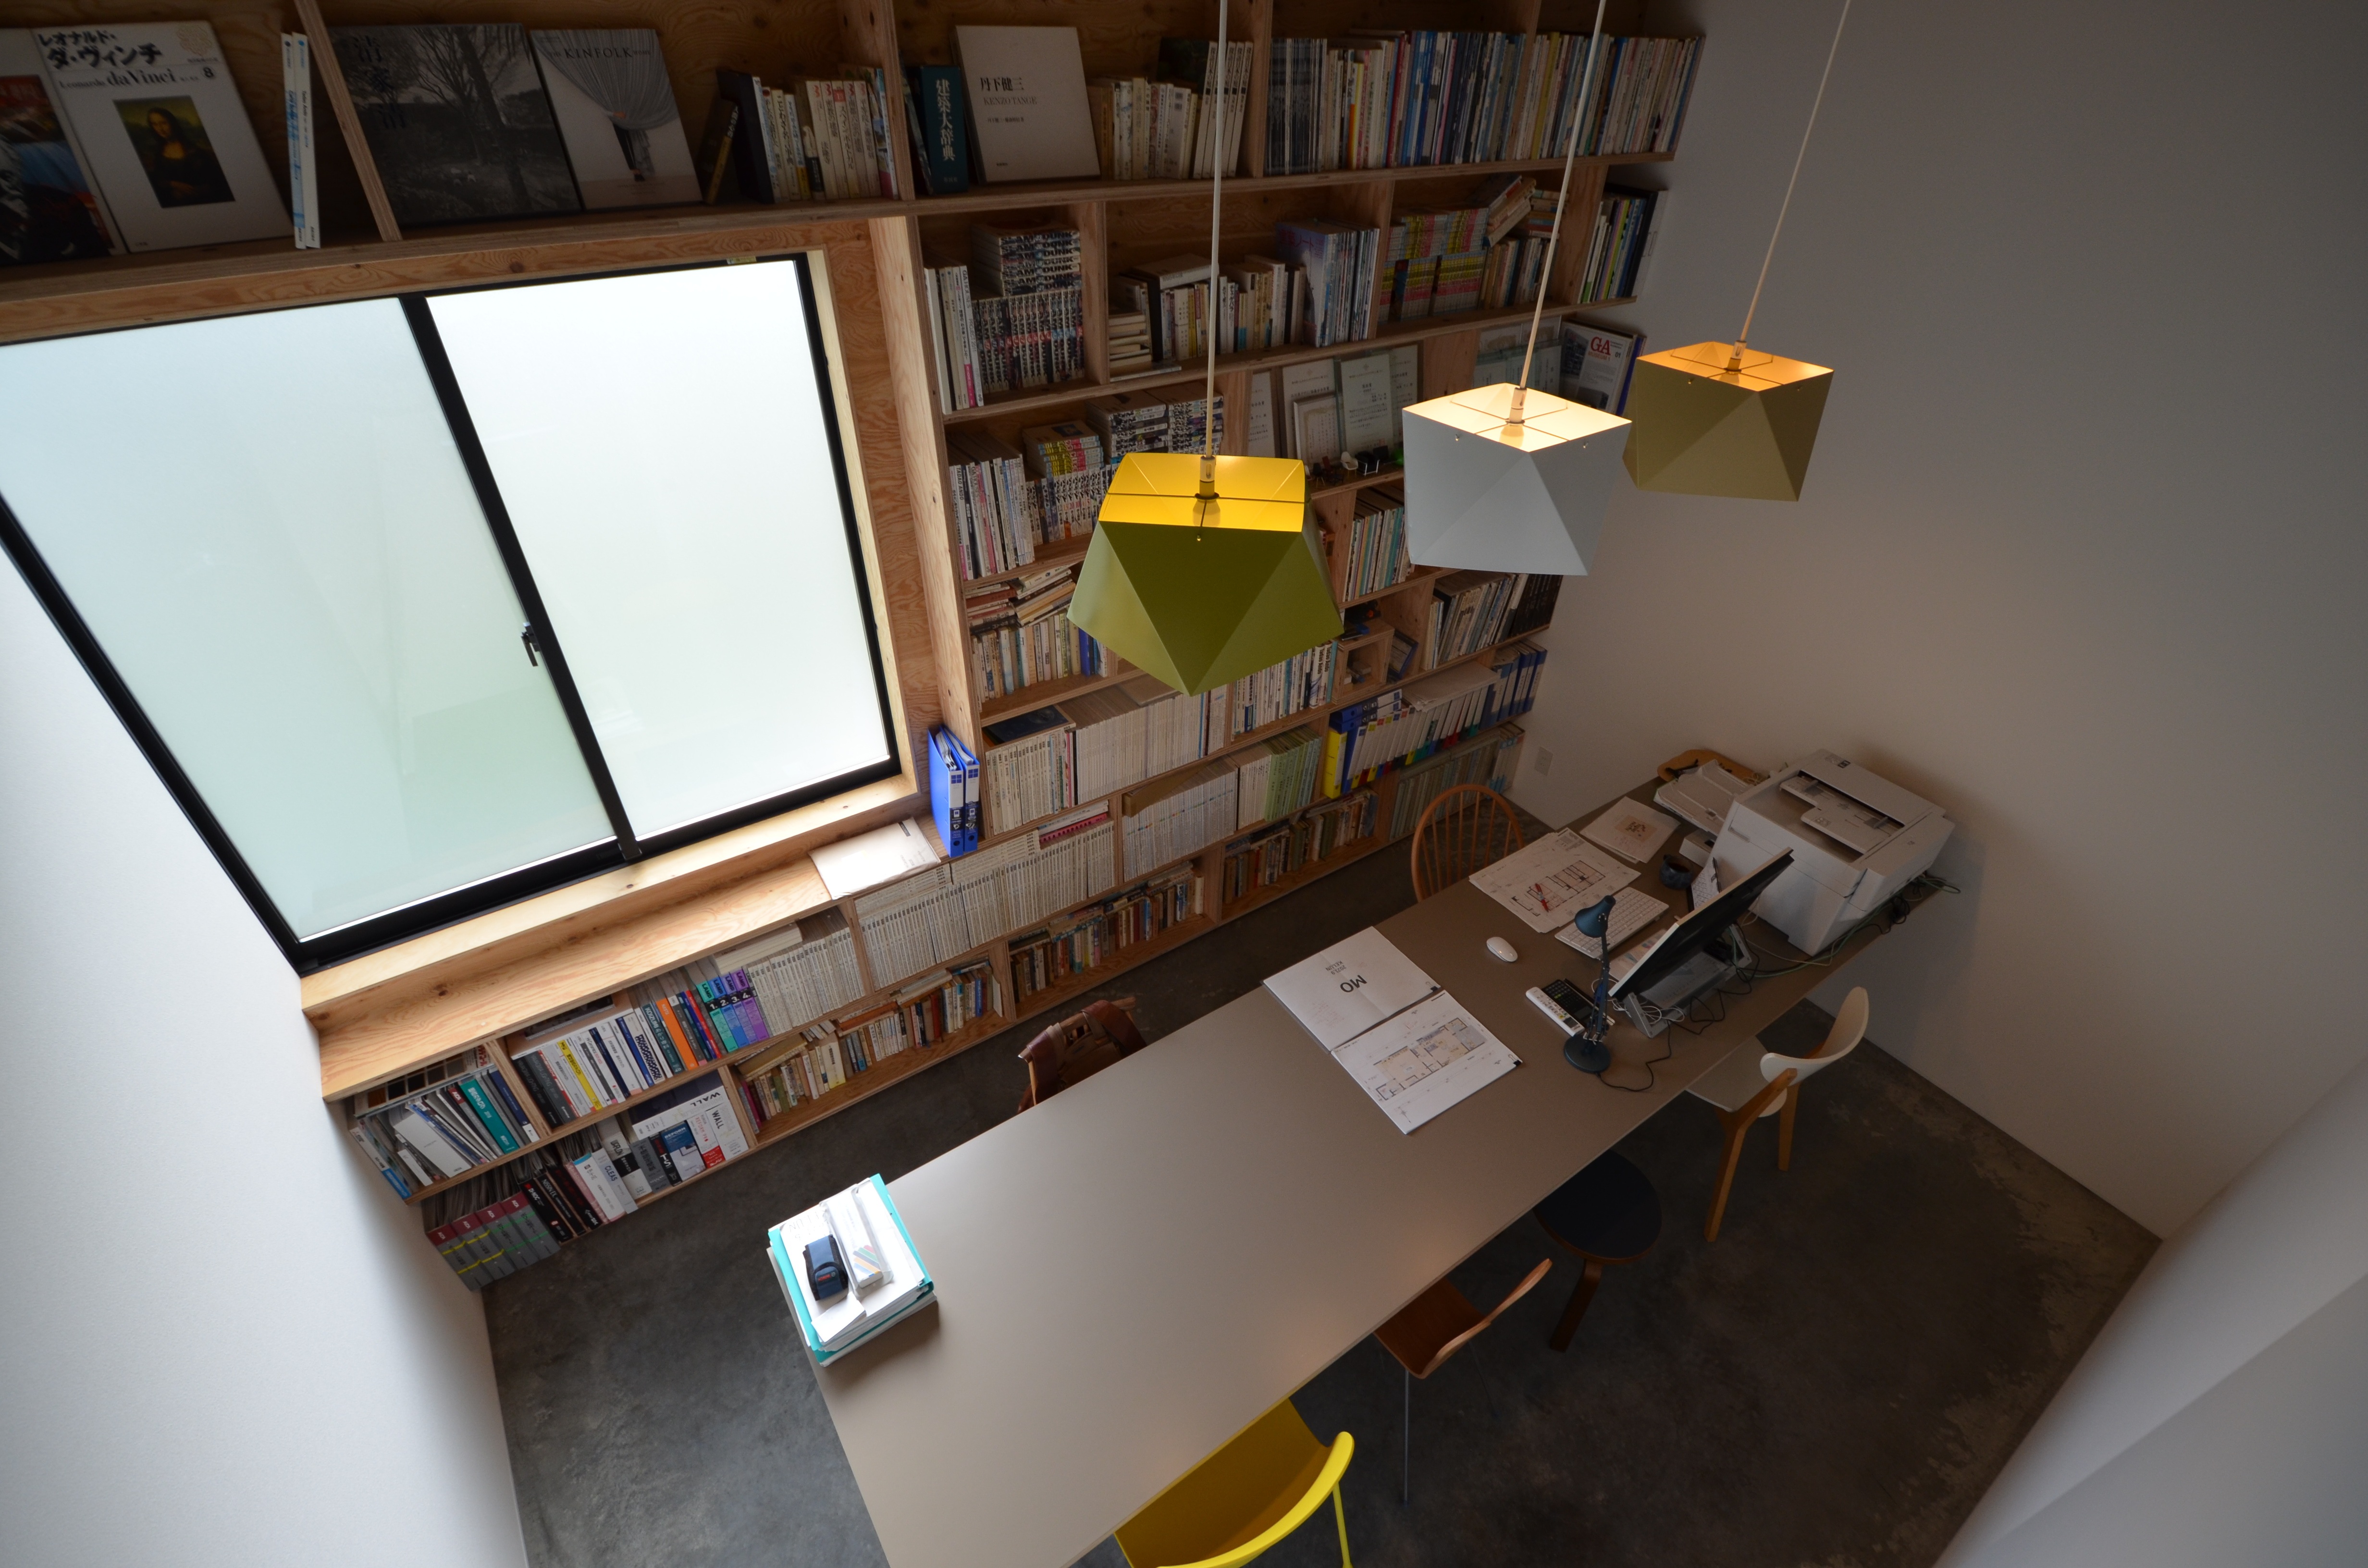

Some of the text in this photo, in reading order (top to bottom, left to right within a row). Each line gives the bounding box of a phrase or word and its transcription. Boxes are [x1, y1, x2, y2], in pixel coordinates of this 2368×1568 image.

[48, 43, 163, 69] ダ・ヴィンチ
[565, 46, 633, 59] KINFOLK
[979, 76, 1024, 92] 丹下健三
[983, 96, 1037, 106] KENZO TANGE
[935, 77, 956, 161] 建築大辞典
[1043, 247, 1073, 257] DUNK
[1043, 264, 1072, 272] DUNK
[1590, 336, 1611, 356] GA
[1588, 351, 1606, 360] MUSEUM
[1325, 960, 1343, 972] KELUN
[713, 979, 724, 994] LAMP
[725, 976, 735, 992] LAMP
[736, 972, 746, 988] LAMP
[1340, 974, 1368, 993] MO
[702, 983, 712, 999] LAMP
[645, 1007, 658, 1029] KOIZUMI
[691, 1091, 721, 1107] WALL
[712, 1110, 723, 1129] WALL
[665, 1127, 686, 1139] REFORM
[604, 1165, 617, 1181] CLEAS
